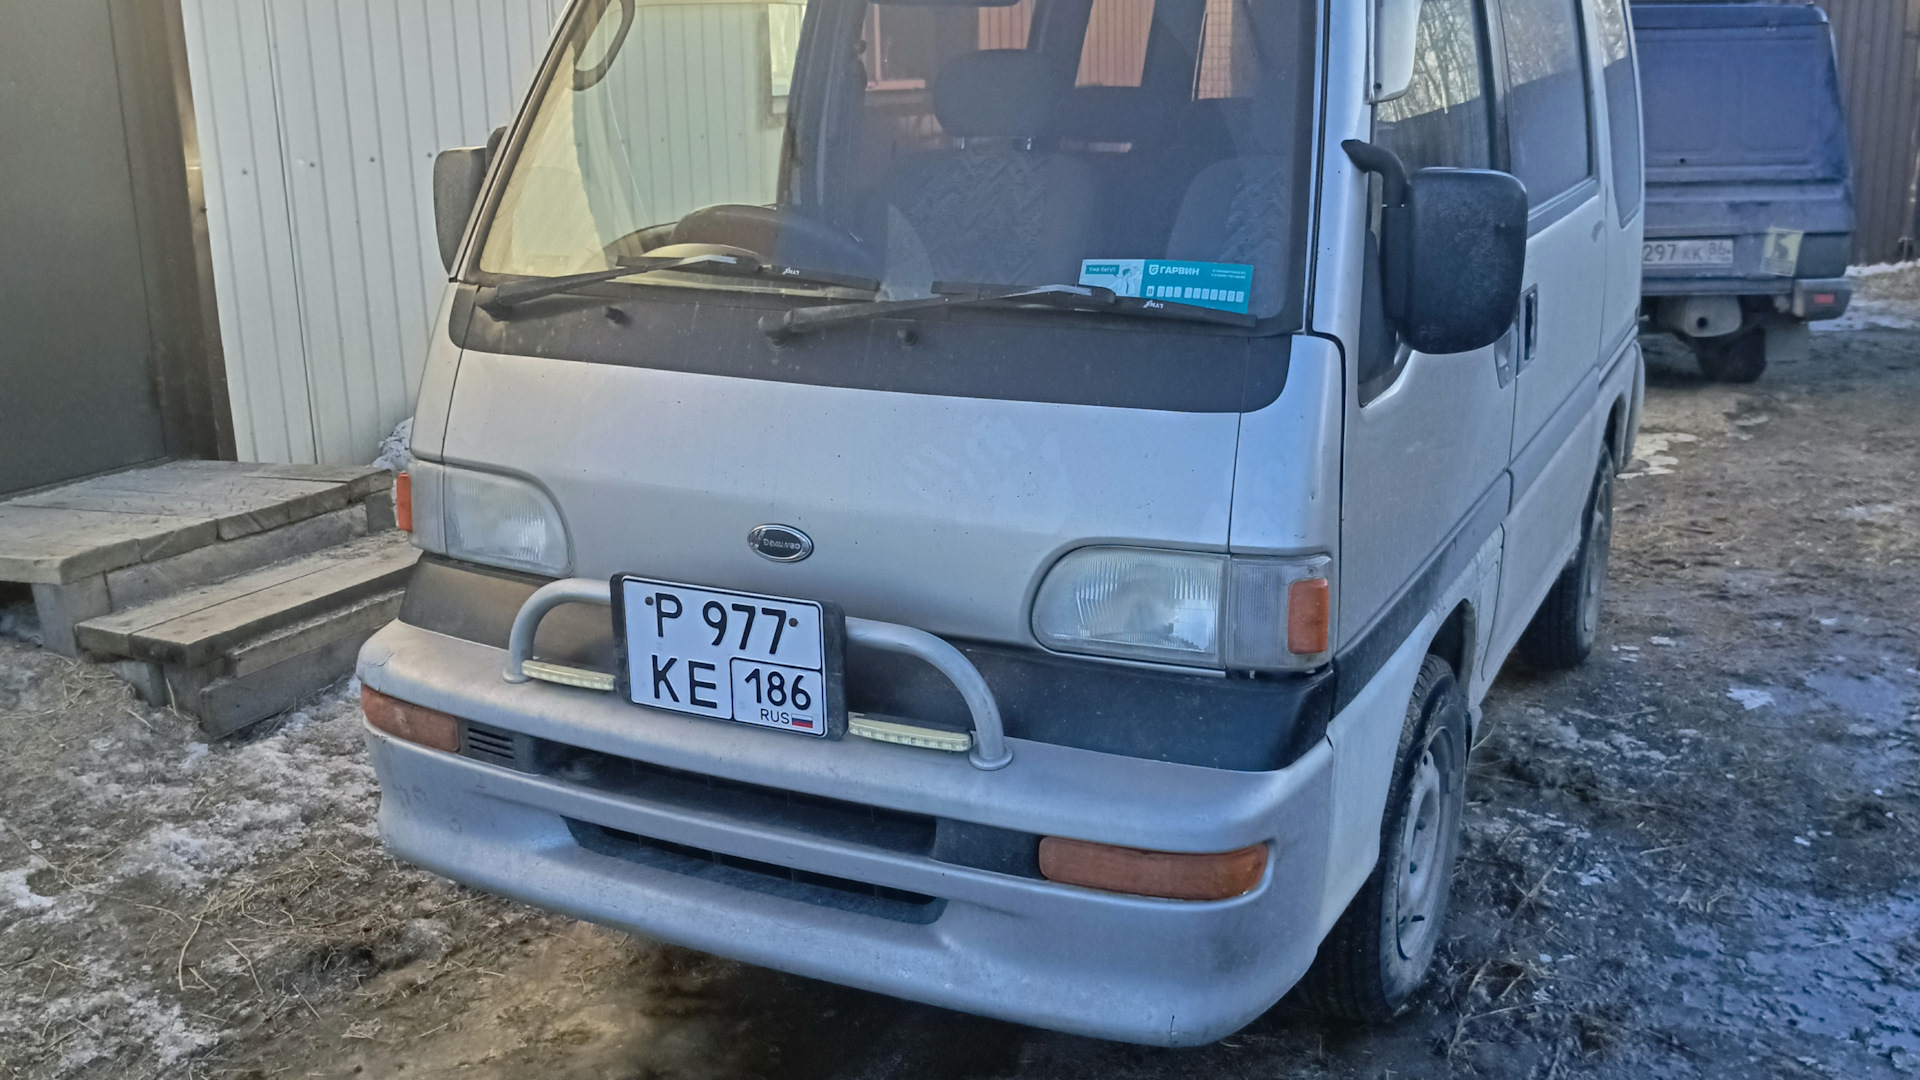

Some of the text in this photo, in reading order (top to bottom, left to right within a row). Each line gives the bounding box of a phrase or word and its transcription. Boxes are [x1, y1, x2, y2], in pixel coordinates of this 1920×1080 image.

[1643, 243, 1677, 262] 297
[1159, 265, 1200, 276] ГАРВИН
[1143, 299, 1164, 309] LYNX
[702, 600, 787, 655] 977
[651, 654, 718, 709] КЕ
[744, 668, 811, 711] 186
[760, 708, 790, 725] RUS
